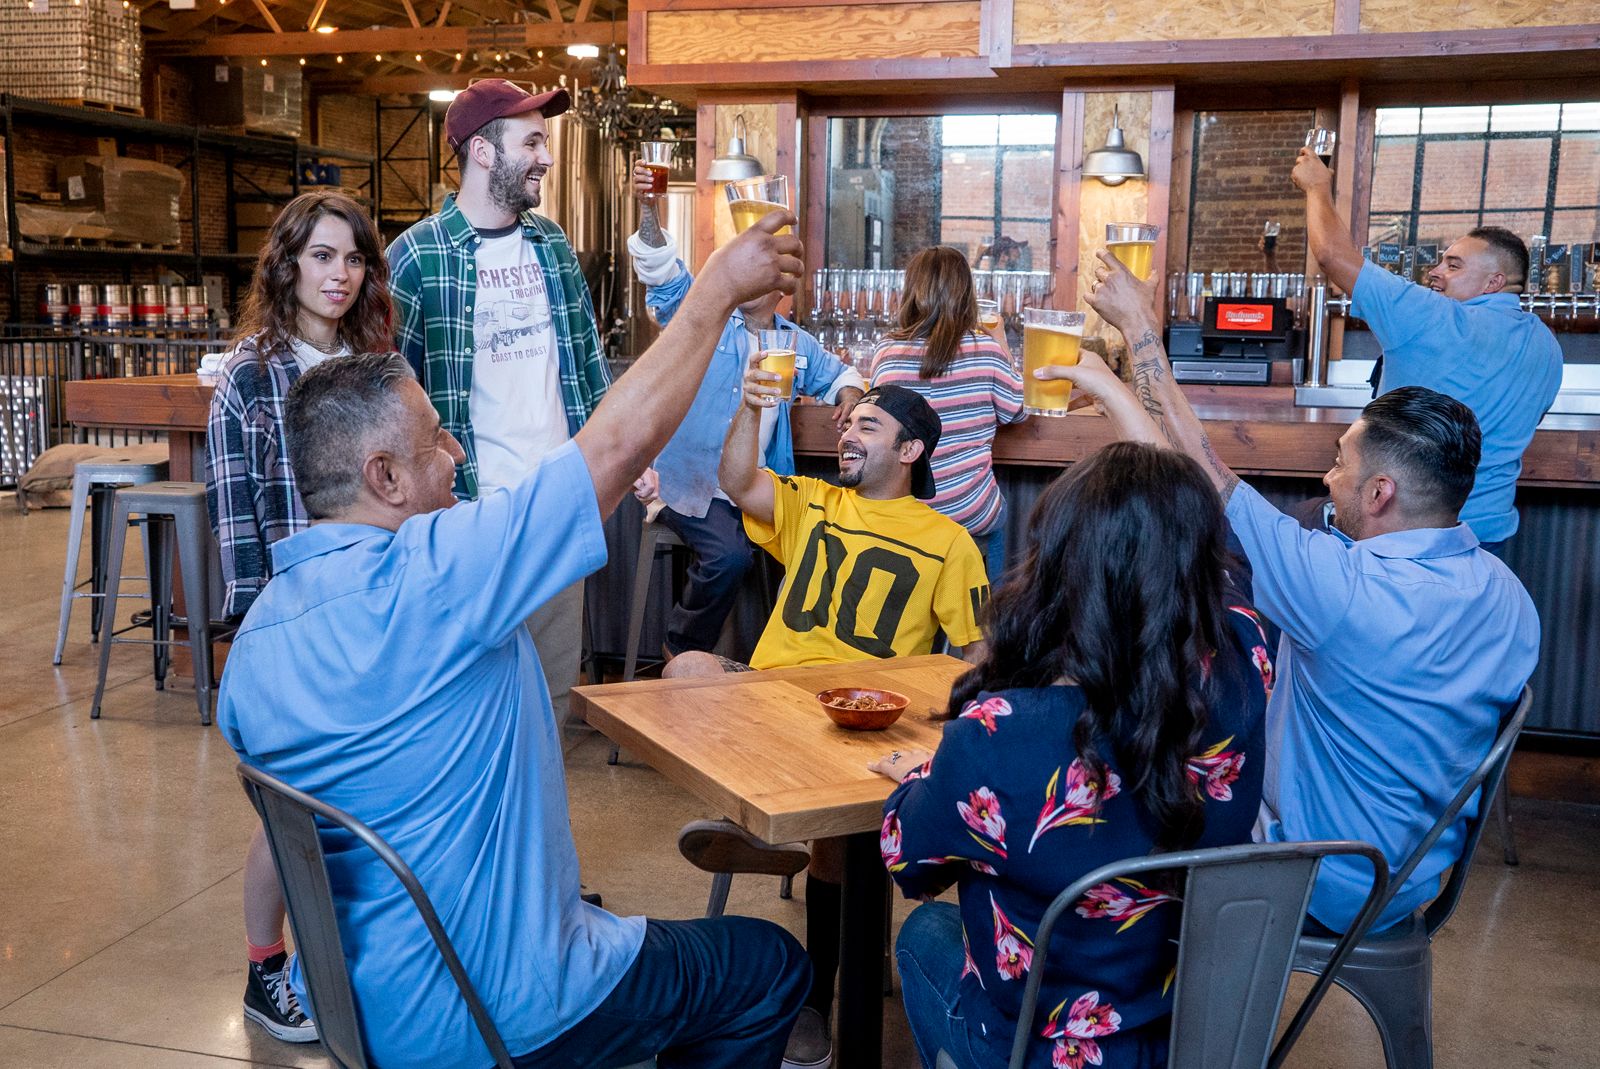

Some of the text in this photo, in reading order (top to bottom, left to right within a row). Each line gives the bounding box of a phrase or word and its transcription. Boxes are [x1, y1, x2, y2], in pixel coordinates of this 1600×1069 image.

[476, 262, 543, 289] CHESTER
[491, 345, 547, 363] COAST TO COAST
